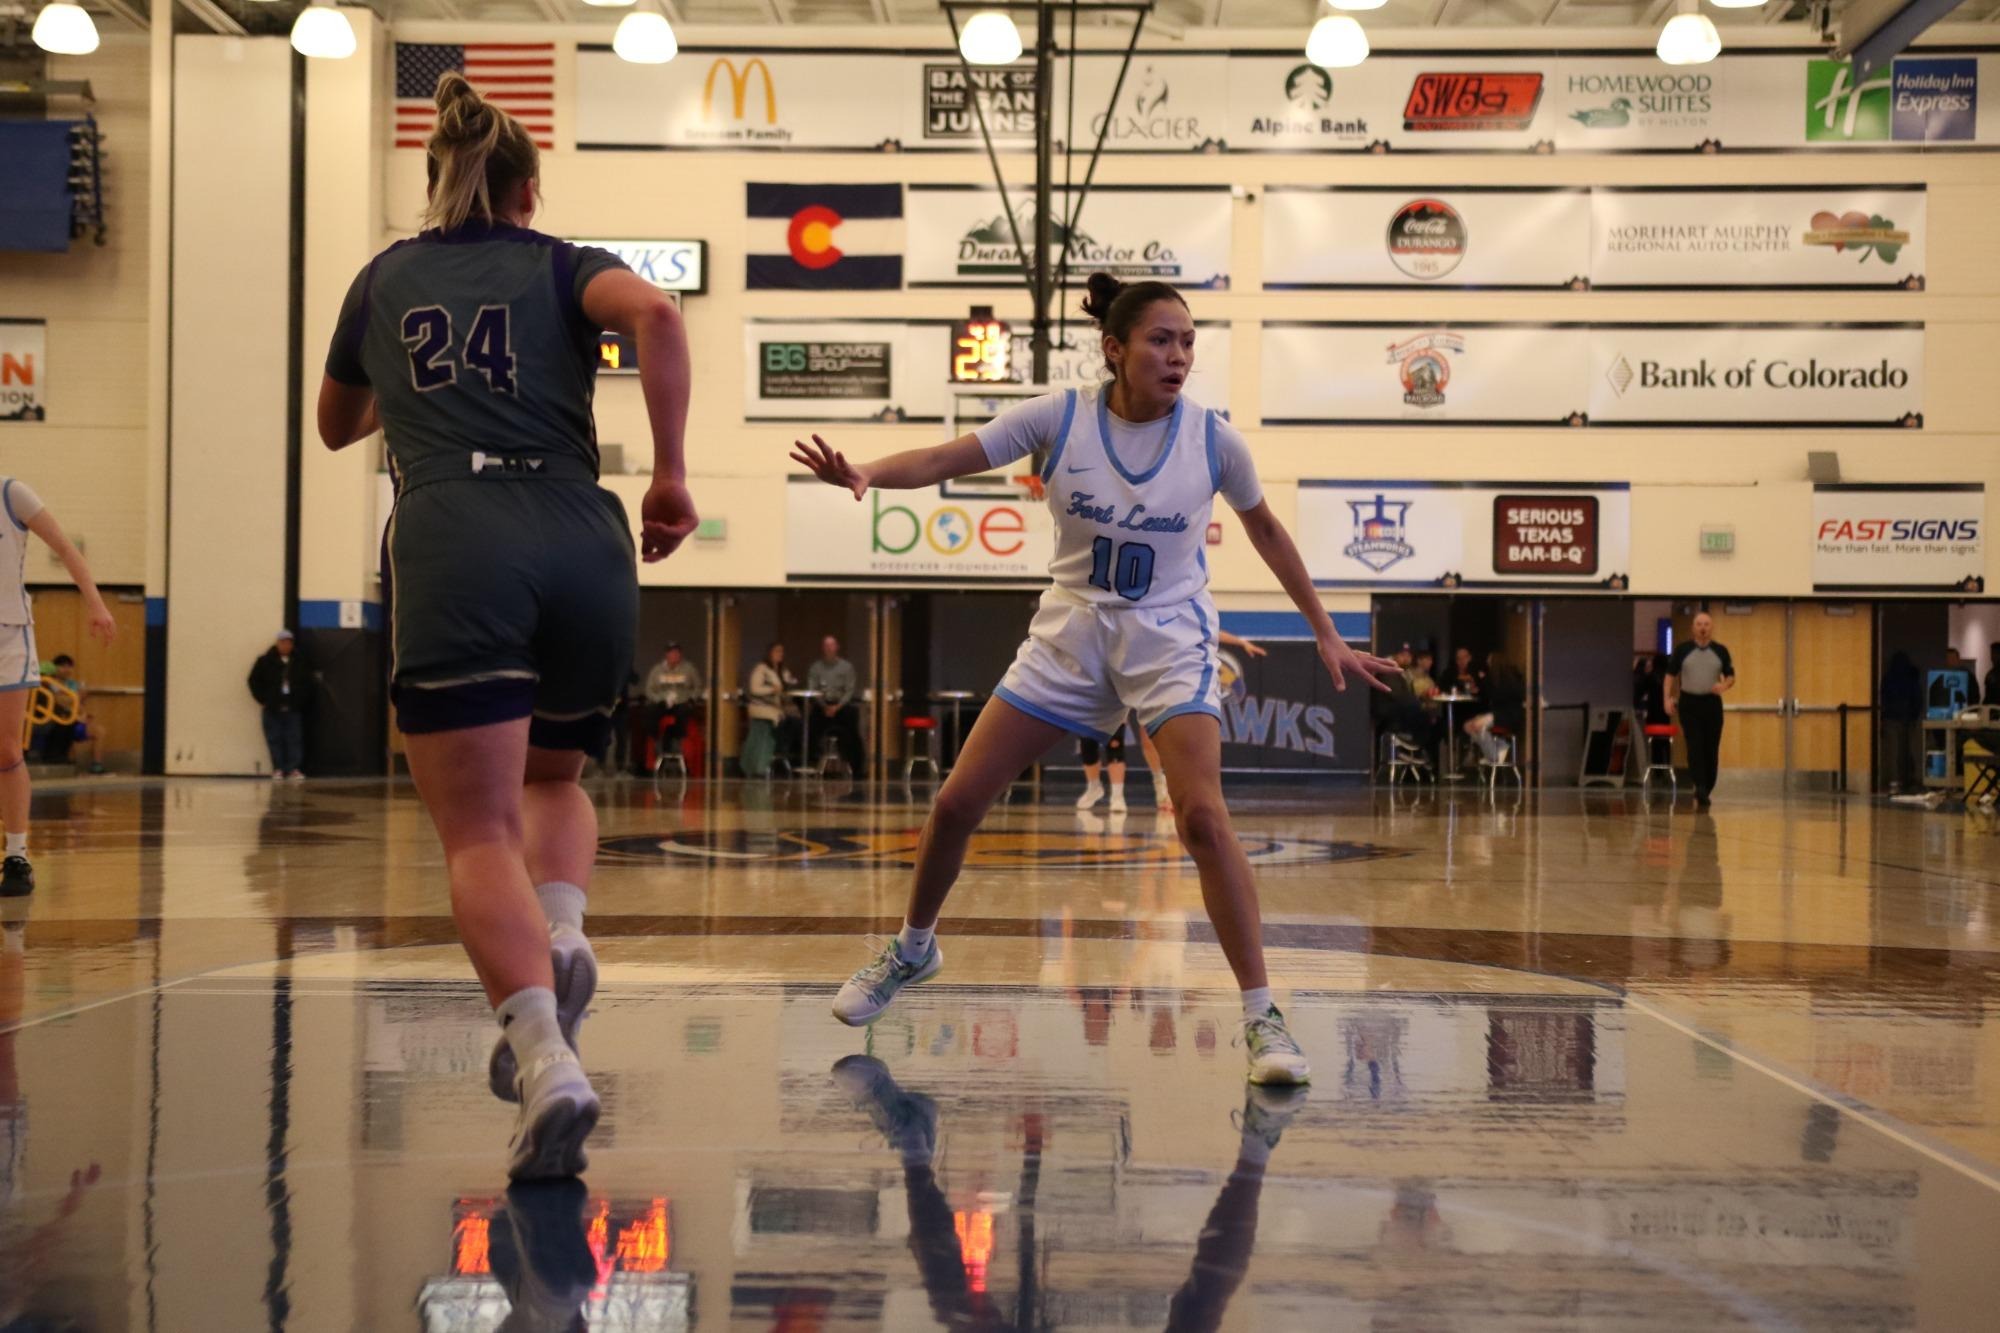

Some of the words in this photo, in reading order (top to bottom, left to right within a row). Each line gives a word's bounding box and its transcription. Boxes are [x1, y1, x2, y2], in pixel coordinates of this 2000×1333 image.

[931, 71, 1007, 89] BANK
[1568, 75, 1712, 93] HOMEWOOD
[1897, 73, 1949, 91] Holiday
[1952, 74, 1974, 88] Inn
[931, 91, 964, 104] THE
[1638, 94, 1711, 113] SUITES
[1896, 91, 1971, 115] Express
[1320, 118, 1367, 133] Bank
[1608, 224, 1708, 239] MOREHART
[1714, 224, 1791, 239] MURPHY
[1397, 237, 1456, 248] DURANGO
[1608, 240, 1681, 251] REGIONAL
[1687, 240, 1728, 251] AUTO
[1733, 240, 1791, 251] CENTER
[401, 304, 518, 398] 24
[767, 344, 806, 371] BG
[1640, 359, 1717, 388] Bank
[1724, 359, 1757, 388] of
[1763, 359, 1908, 389] Colorado
[1067, 491, 1115, 524] Fort
[1117, 504, 1188, 533] Lewis
[1507, 508, 1584, 526] SERIOUS
[872, 489, 1026, 557] boe
[1818, 519, 1978, 541] FASTSIGNS
[1517, 526, 1574, 544] TEXAS
[1347, 540, 1411, 558] STEAMWORKS
[1508, 545, 1582, 564] BAR-B-Q
[1817, 543, 1841, 553] More
[1845, 543, 1868, 553] than
[1896, 543, 1922, 553] More
[1925, 543, 1947, 554] than
[1089, 535, 1156, 601] 10
